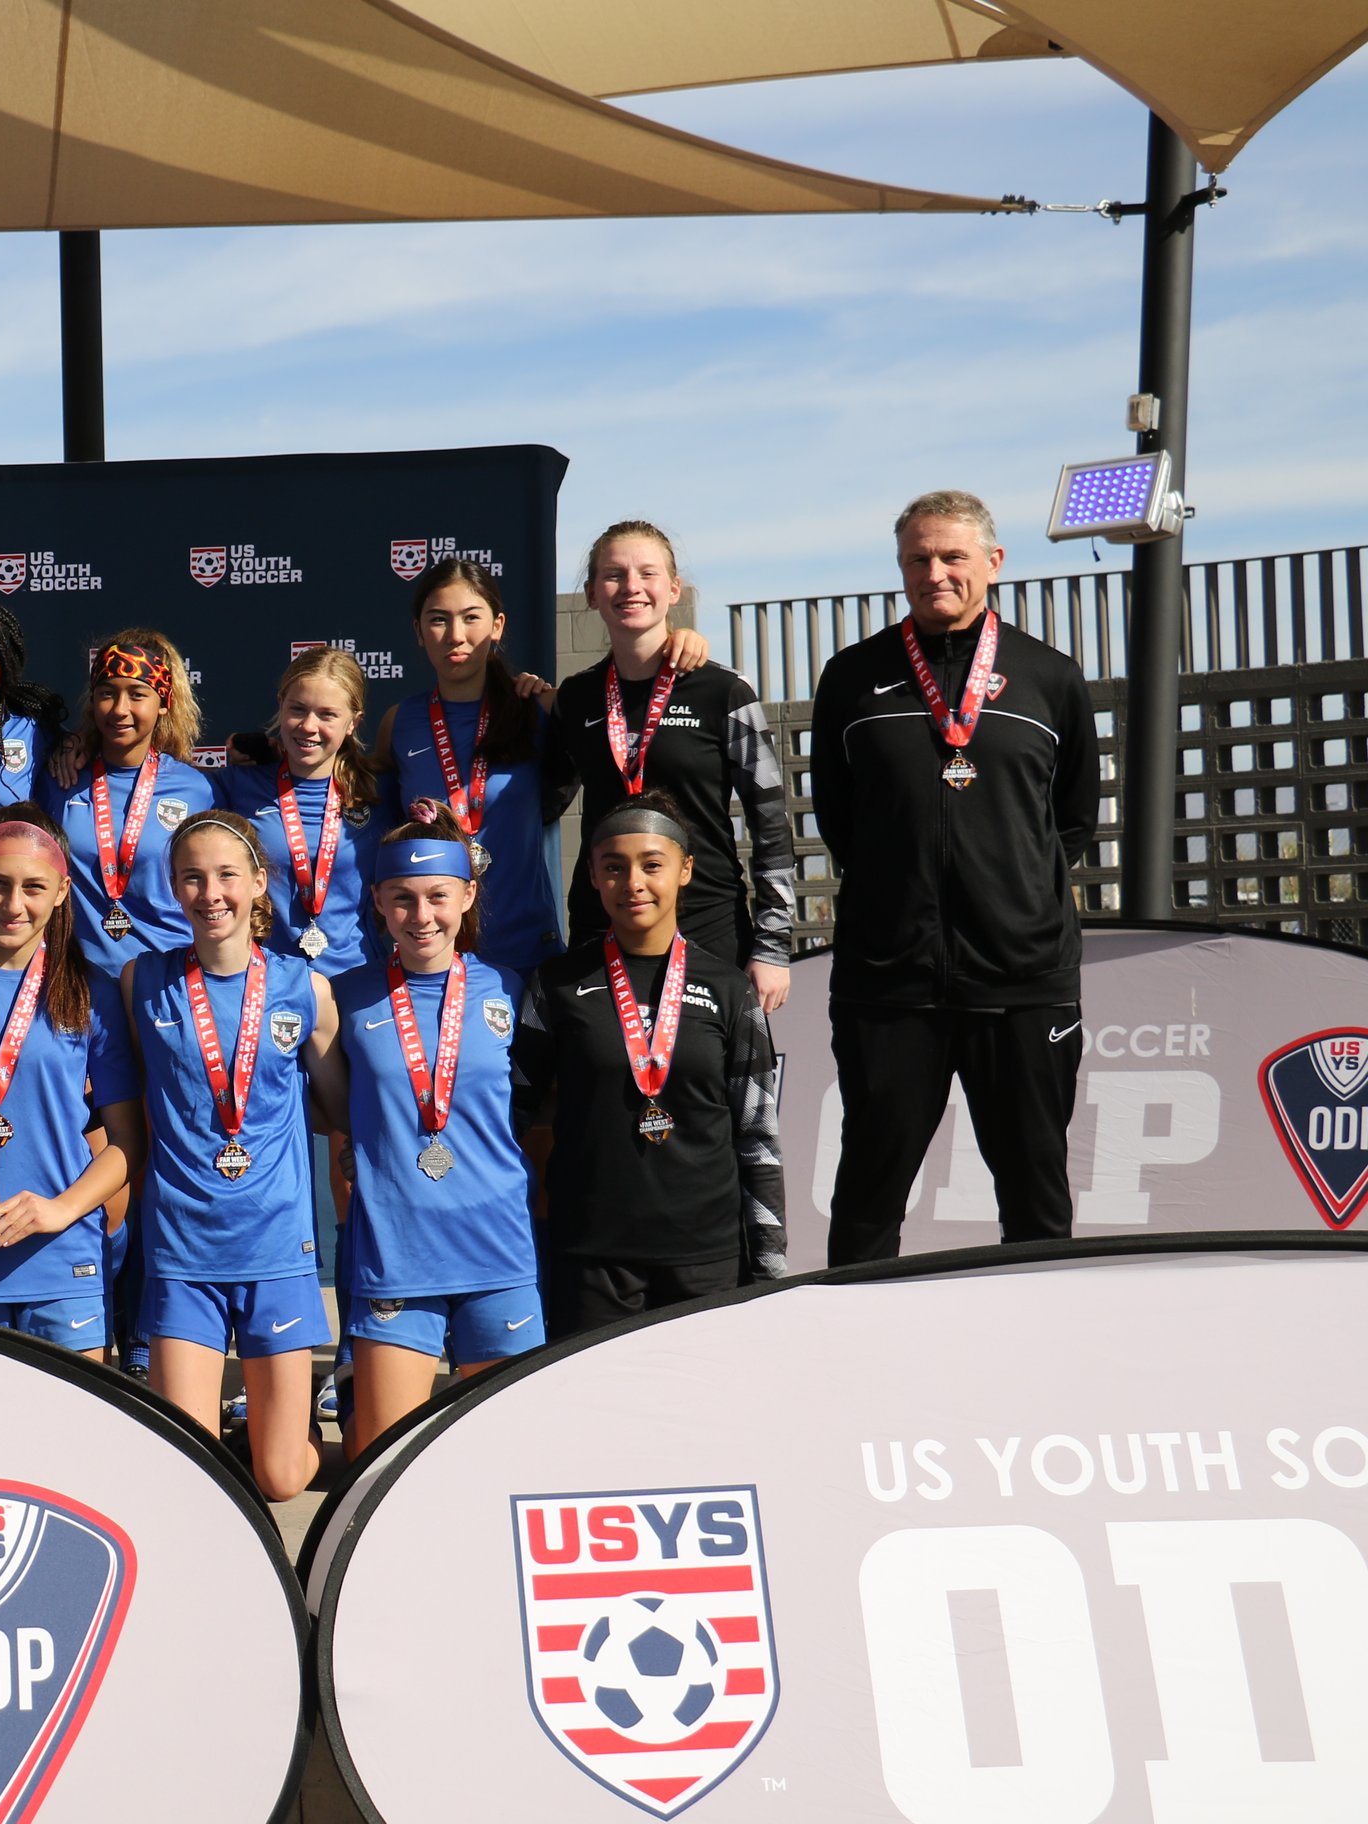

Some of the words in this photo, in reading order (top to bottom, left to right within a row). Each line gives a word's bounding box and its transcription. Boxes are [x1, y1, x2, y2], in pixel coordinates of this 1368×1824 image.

[230, 544, 255, 557] US
[431, 537, 456, 551] US
[29, 552, 55, 565] US
[230, 556, 291, 571] YOUTH
[29, 563, 91, 578] YOUTH
[230, 569, 302, 585] SOCCER
[29, 576, 103, 591] SOCCER
[906, 633, 940, 706] FINALIST
[640, 675, 671, 752] FINALIST
[668, 705, 693, 715] CAL
[659, 717, 701, 728] NORTH
[434, 719, 462, 792] FINALIST
[95, 774, 113, 850] FINALIST
[282, 795, 309, 873] FINALIST
[686, 983, 711, 998] CAL
[610, 958, 642, 1041] FINALIST
[190, 981, 223, 1073] FINALIST
[393, 987, 426, 1074] FINALIST
[1330, 1041, 1360, 1056] US
[1331, 1056, 1359, 1071] YS
[860, 1438, 955, 1503] US
[974, 1430, 1243, 1497] YOUTH
[525, 1499, 749, 1566] USYS
